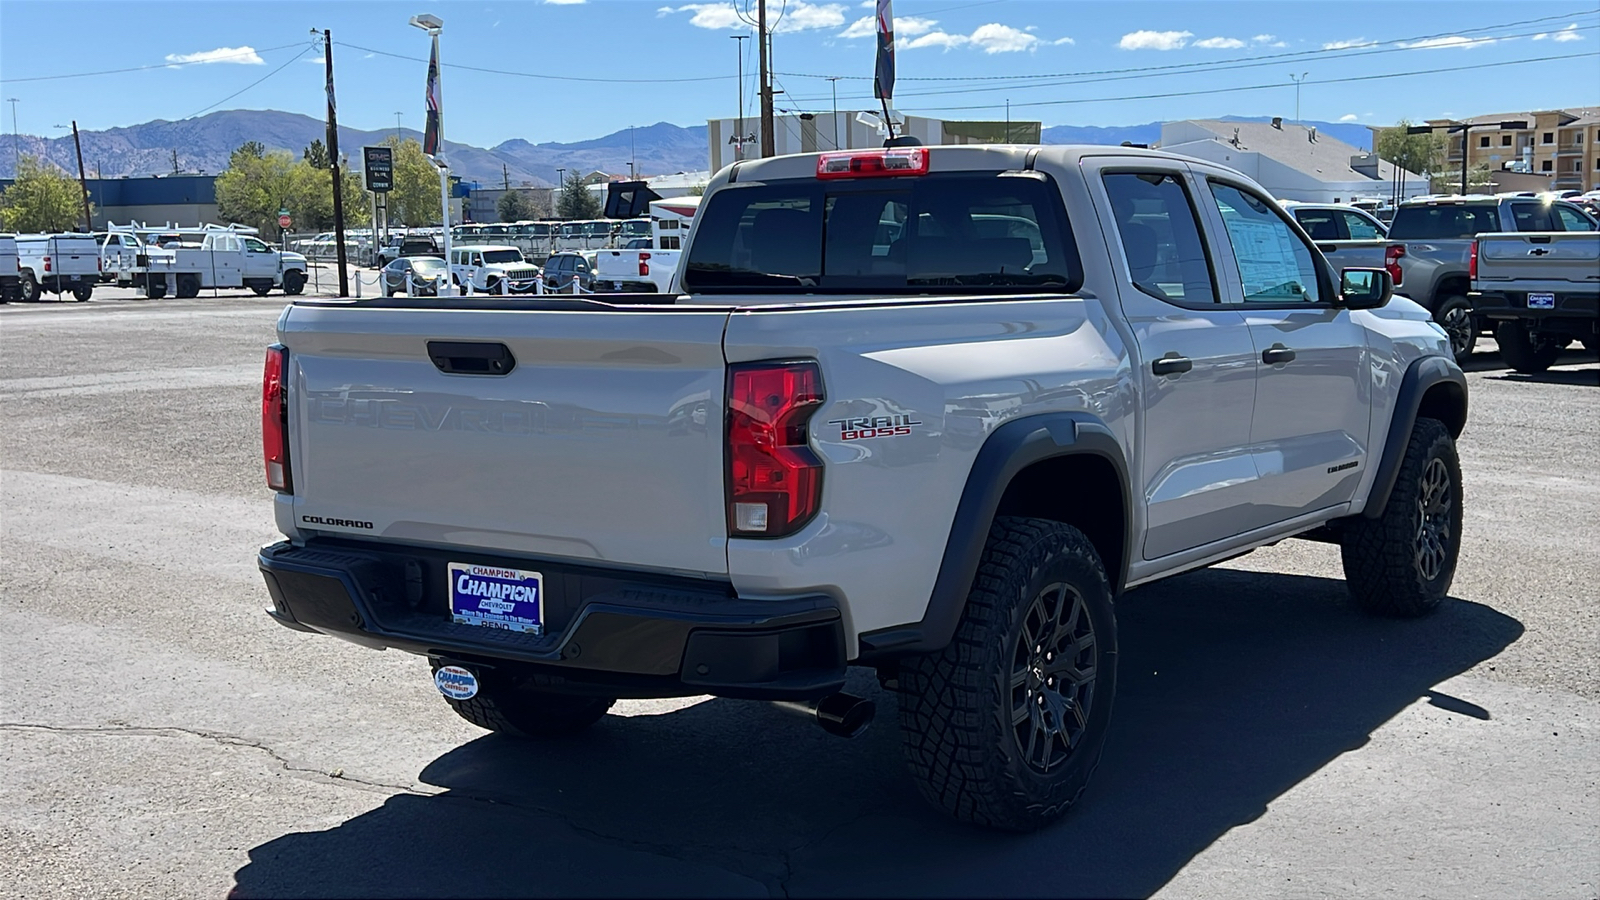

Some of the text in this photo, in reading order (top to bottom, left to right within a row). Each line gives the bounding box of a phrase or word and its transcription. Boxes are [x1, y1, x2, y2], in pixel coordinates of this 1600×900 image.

[368, 153, 390, 161] GMC
[828, 414, 922, 431] TRAIL
[841, 426, 911, 441] BOSS
[302, 515, 374, 529] COLORADO
[472, 566, 516, 579] CHAMPION
[457, 574, 537, 603] CHAMPION
[481, 600, 513, 611] CHEVROLET
